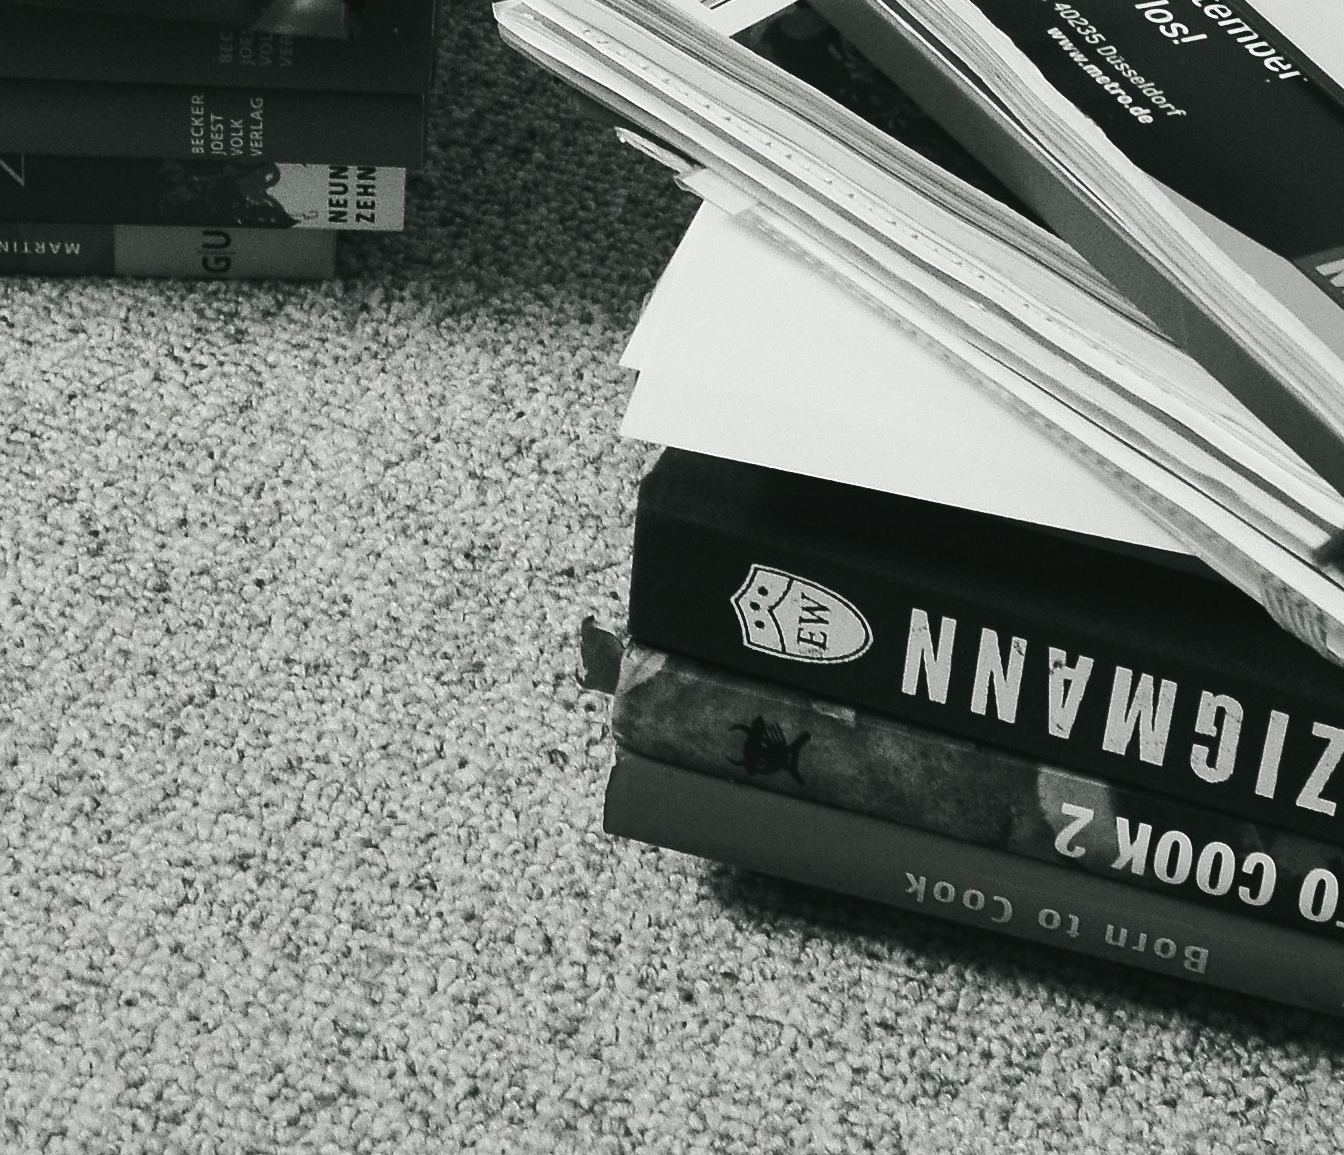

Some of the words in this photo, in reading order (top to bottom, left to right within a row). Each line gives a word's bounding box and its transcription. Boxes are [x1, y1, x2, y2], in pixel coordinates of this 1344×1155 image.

[1134, 0, 1208, 46] los!
[1046, 26, 1155, 125] www.metro.de
[1053, 2, 1107, 45] 40235
[1096, 45, 1187, 117] Düsseldorf
[189, 93, 205, 155] BECKER
[209, 111, 228, 157] JOEST
[229, 117, 245, 157] VOLK
[248, 96, 265, 158] VERLAG
[328, 165, 350, 224] NEUN
[356, 166, 377, 224] ZEHN
[797, 592, 832, 651] EW
[1054, 802, 1094, 858] 2
[1111, 817, 1277, 907] COOK
[905, 869, 1014, 925] Cook
[1037, 906, 1080, 940] to
[1104, 923, 1209, 975] Born
